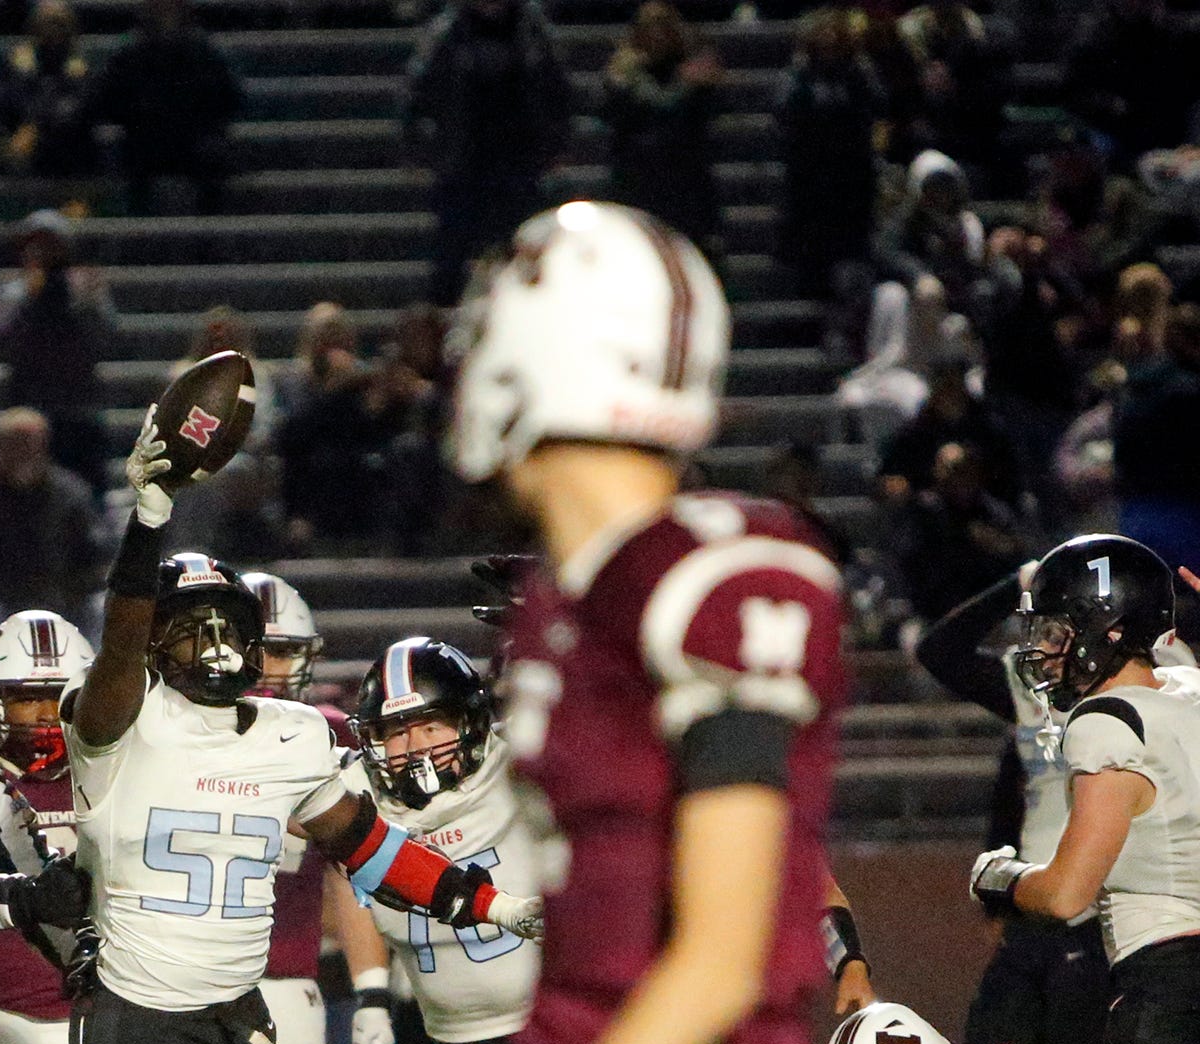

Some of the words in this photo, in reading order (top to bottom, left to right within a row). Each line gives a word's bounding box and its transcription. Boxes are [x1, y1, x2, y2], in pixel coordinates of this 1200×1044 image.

[1086, 556, 1111, 597] 1
[196, 778, 260, 797] HUSKIES
[421, 829, 463, 846] SKIES
[140, 807, 282, 919] 52
